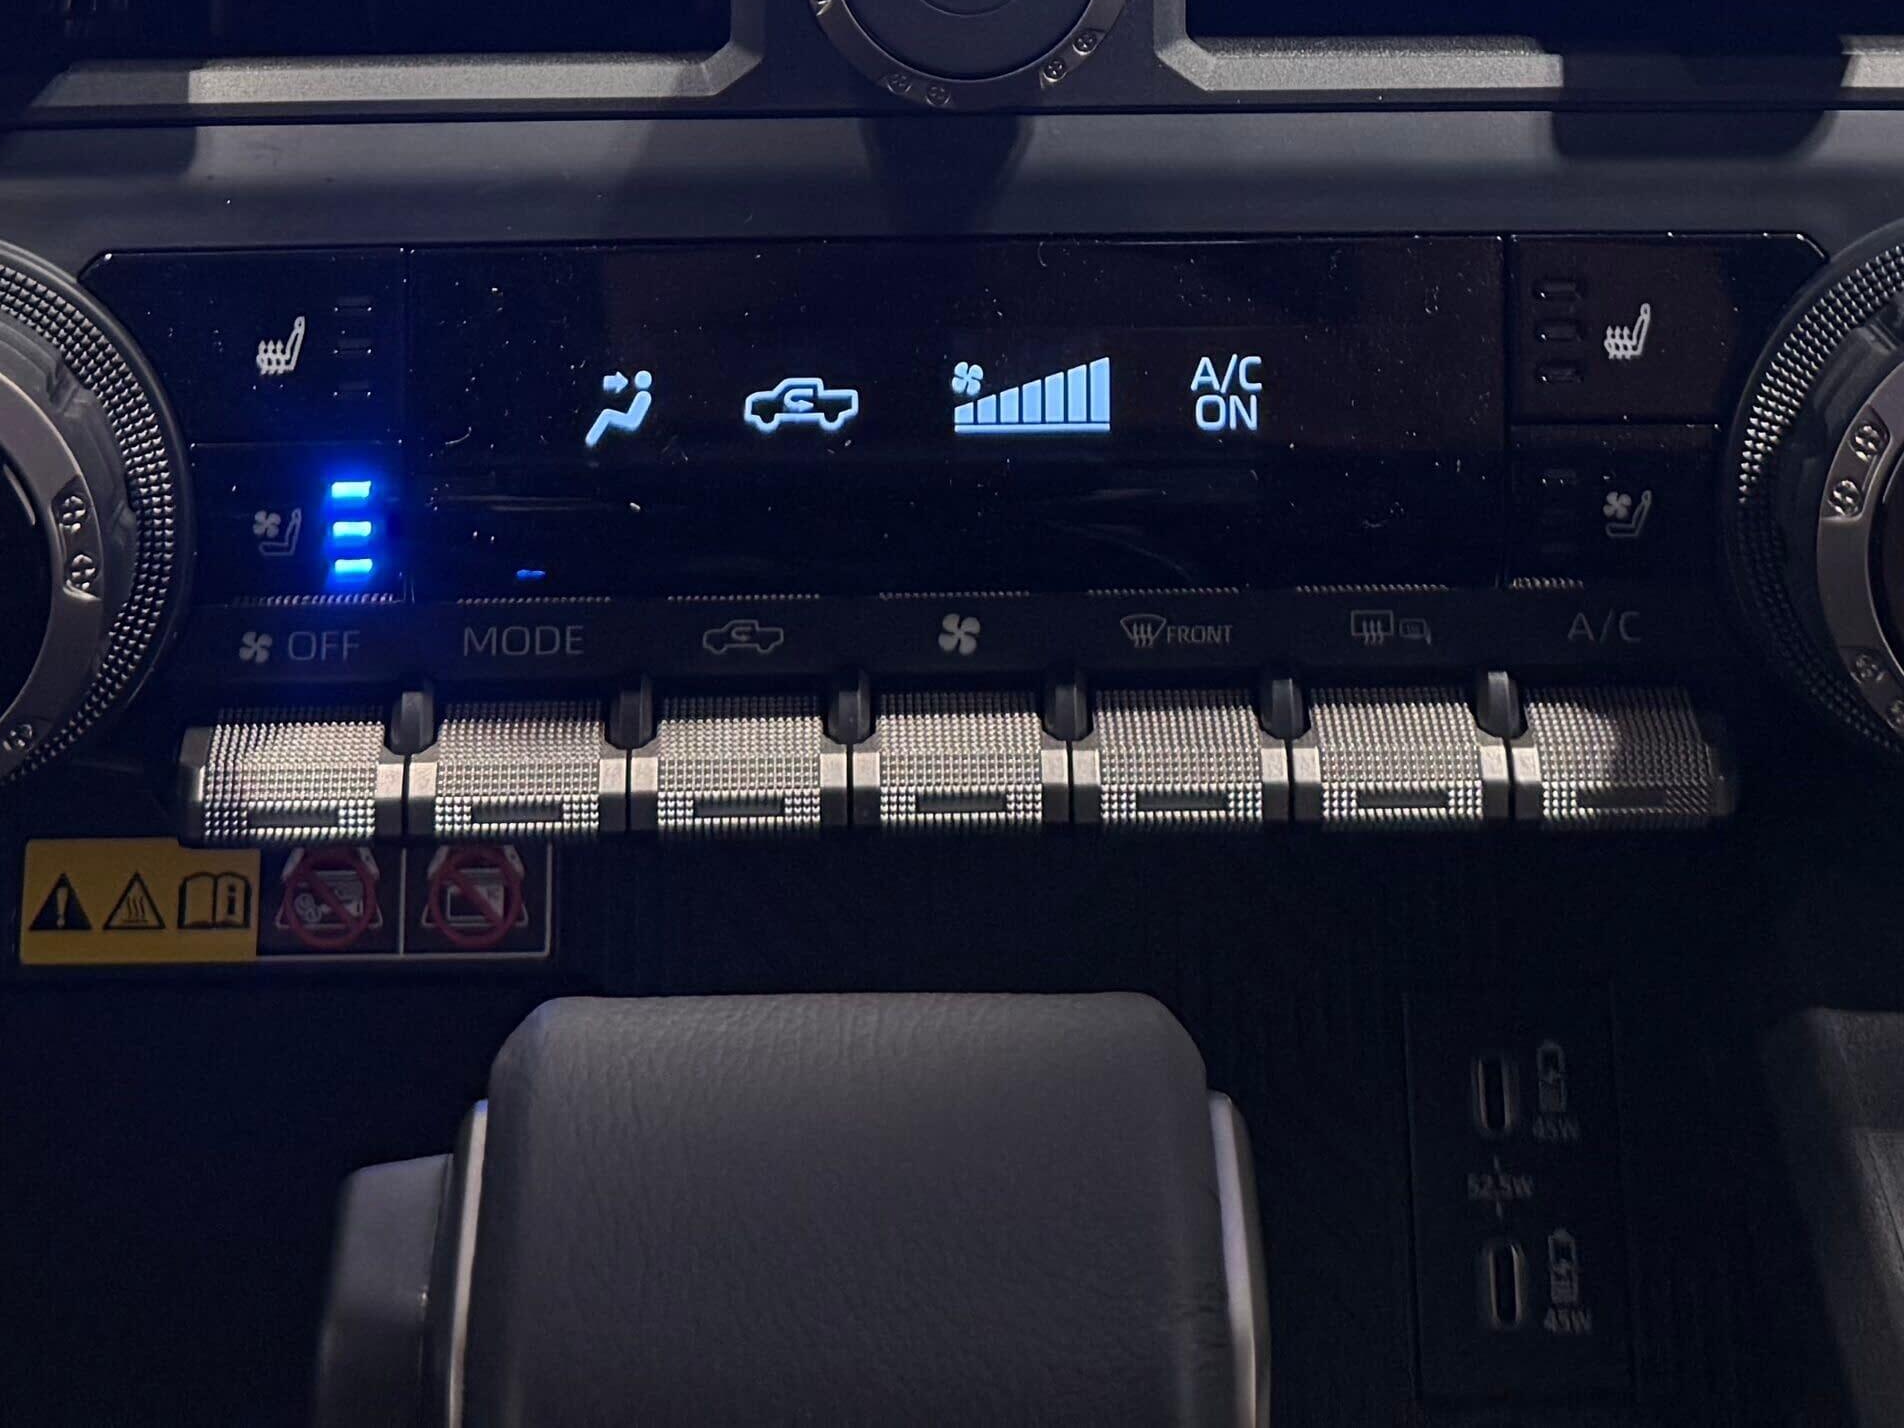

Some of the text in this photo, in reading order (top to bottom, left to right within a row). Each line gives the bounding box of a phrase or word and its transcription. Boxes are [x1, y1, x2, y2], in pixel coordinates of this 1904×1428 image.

[1191, 353, 1264, 394] A/C
[1194, 394, 1259, 434] ON
[462, 626, 585, 657] MODE
[1165, 622, 1234, 646] FRONT
[1566, 610, 1642, 644] A/C
[286, 630, 362, 662] OFF
